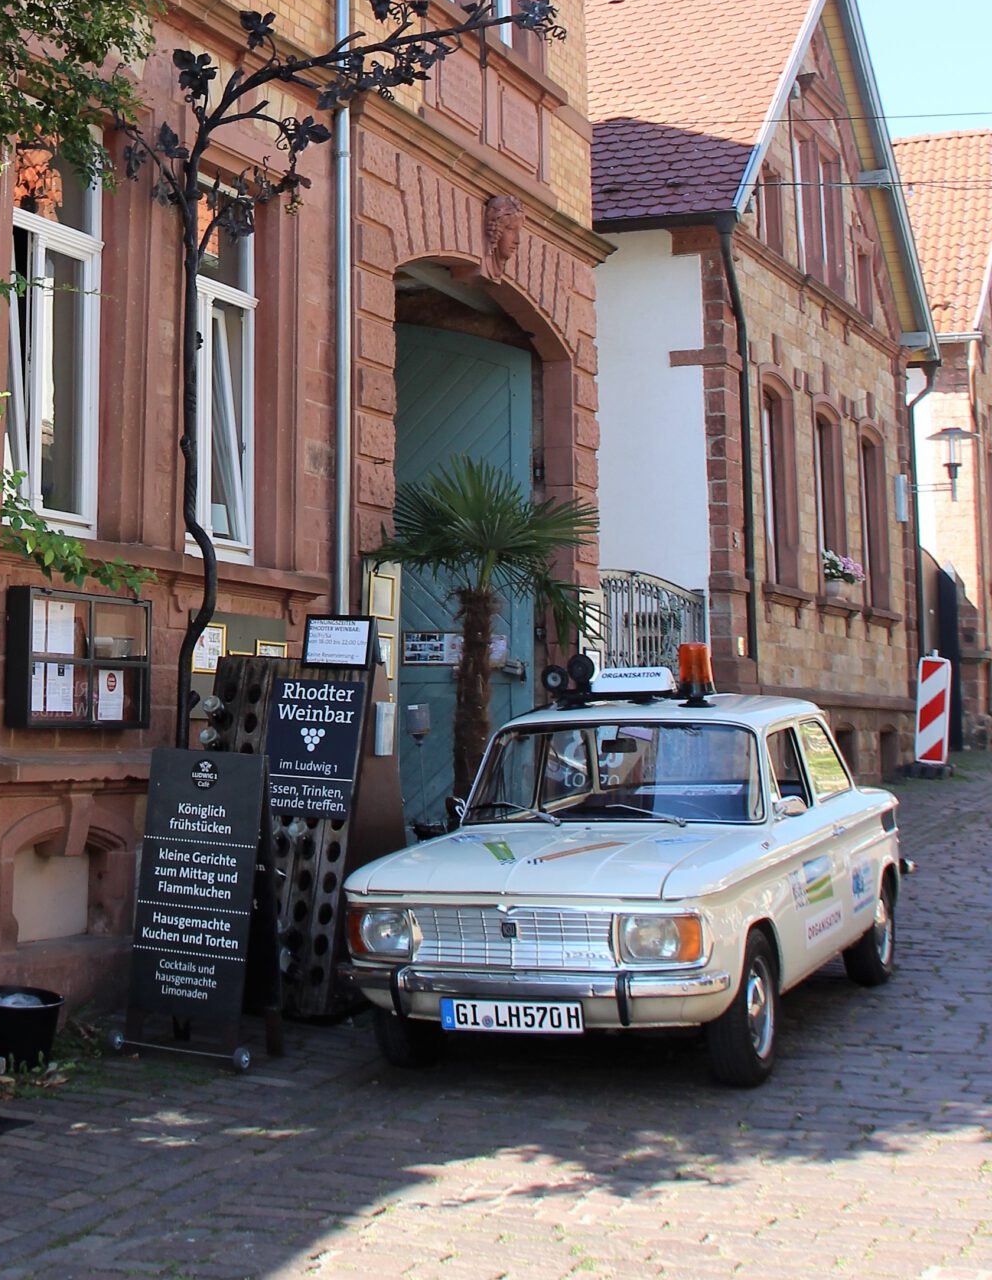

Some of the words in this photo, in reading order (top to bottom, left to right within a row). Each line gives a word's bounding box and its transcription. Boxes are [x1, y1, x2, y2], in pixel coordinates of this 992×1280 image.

[601, 671, 661, 679] ORGANISATION
[282, 682, 355, 702] Rhodter
[278, 703, 355, 724] Weinbar
[279, 759, 293, 770] im
[294, 759, 332, 776] Ludwig
[333, 764, 338, 773] 1
[301, 784, 344, 800] Trinken,
[178, 802, 226, 819] Königlich
[306, 798, 347, 813] treffen.
[169, 817, 232, 835] frühstücken
[159, 847, 190, 862] kleine
[192, 852, 237, 867] Gerichte
[154, 866, 177, 878] zum
[179, 866, 215, 884] Mittag
[217, 872, 238, 884] und
[157, 880, 231, 900] Flammkuchen
[152, 911, 231, 932] Hausgemachte
[142, 926, 180, 942] Kuchen
[182, 933, 202, 945] und
[204, 934, 239, 950] Torten
[159, 958, 197, 973] Cocktails
[198, 965, 215, 975] und
[155, 971, 217, 989] hausgemachte
[161, 984, 208, 1000] Limonaden
[455, 1003, 481, 1026] GI
